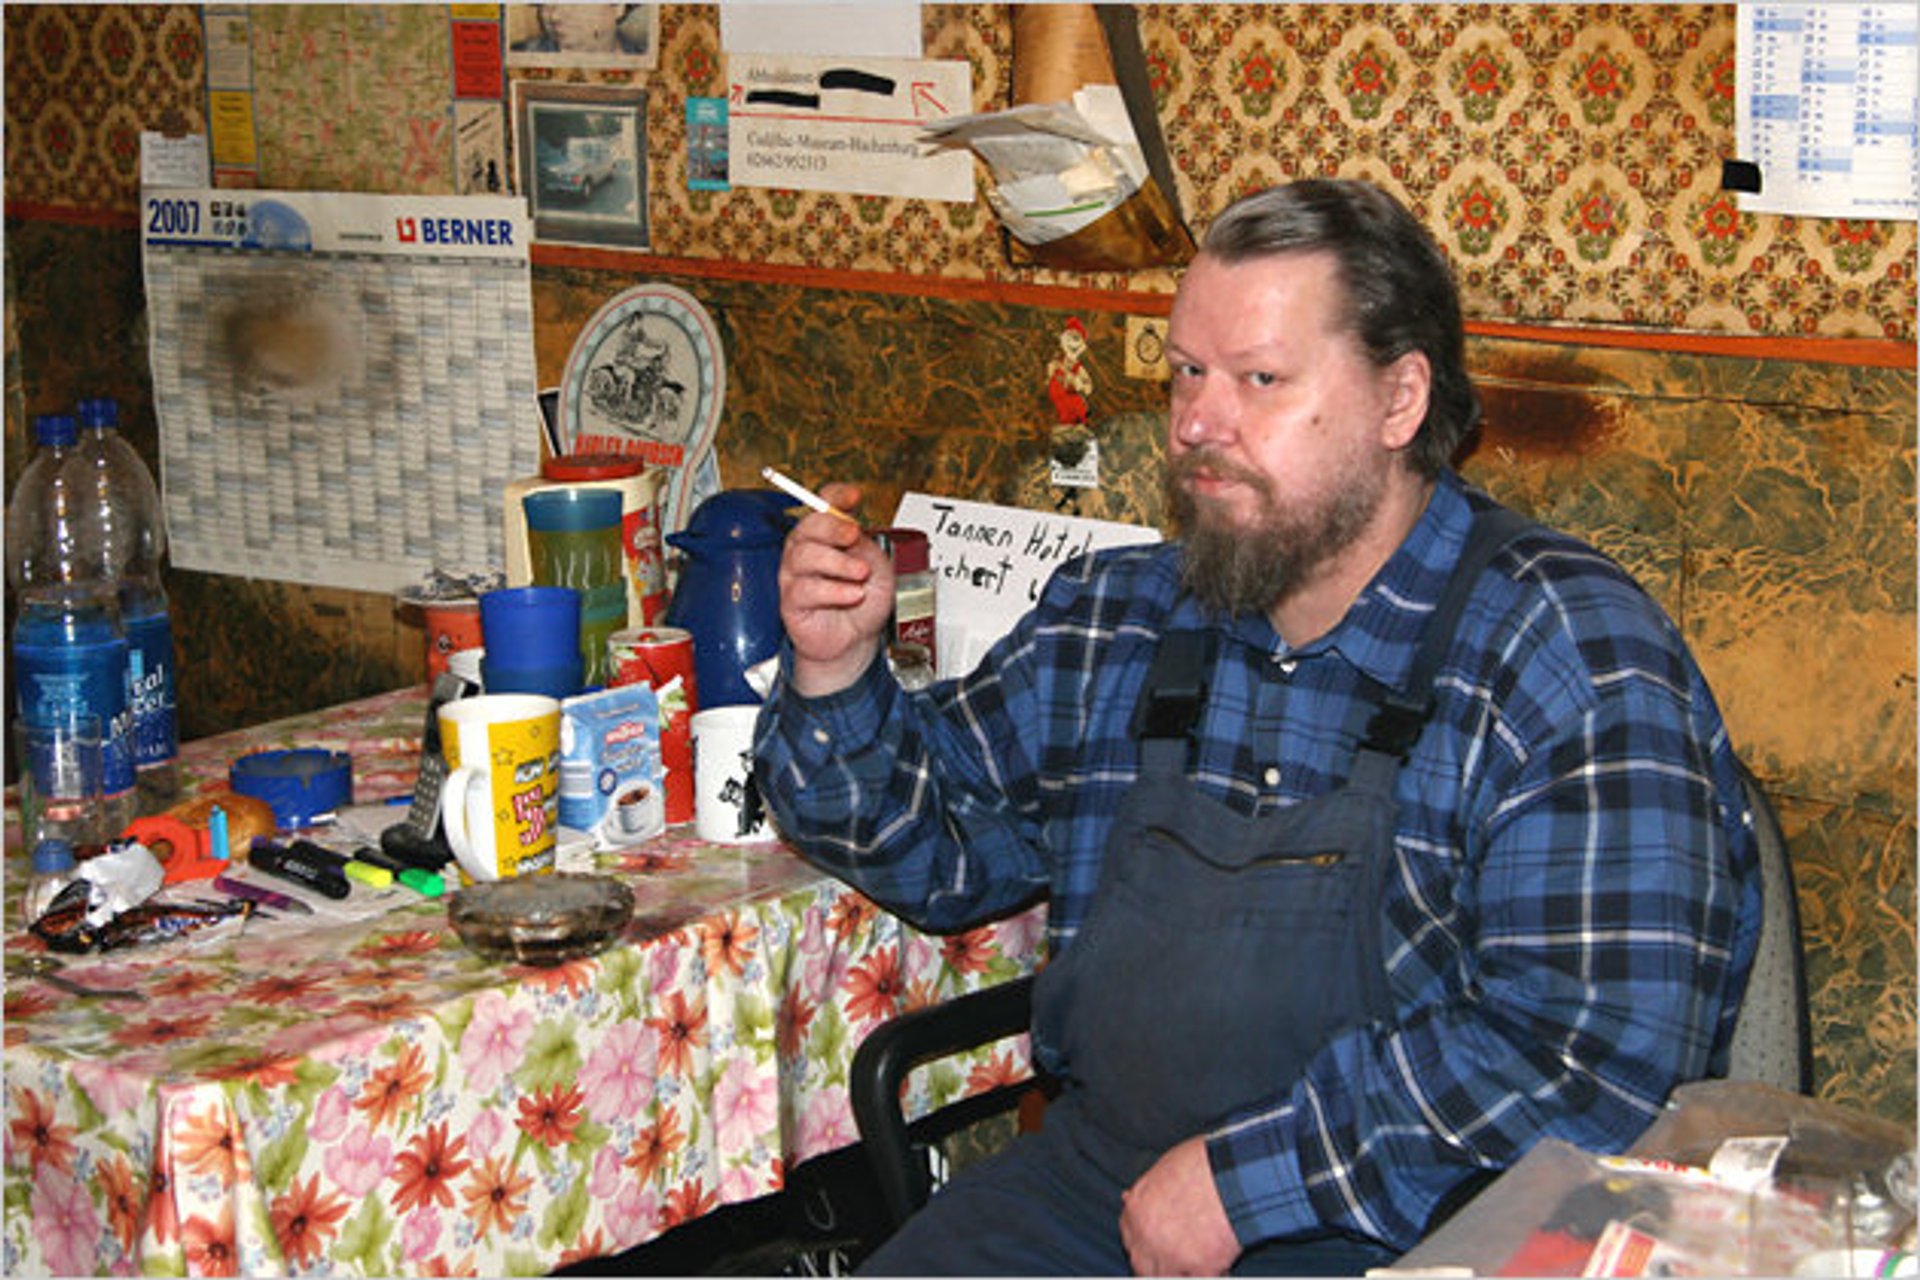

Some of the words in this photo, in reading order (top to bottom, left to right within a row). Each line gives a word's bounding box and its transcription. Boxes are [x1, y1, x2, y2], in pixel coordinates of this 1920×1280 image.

[148, 199, 199, 235] 2007
[421, 218, 514, 246] BERNER
[932, 503, 1013, 547] Tannen
